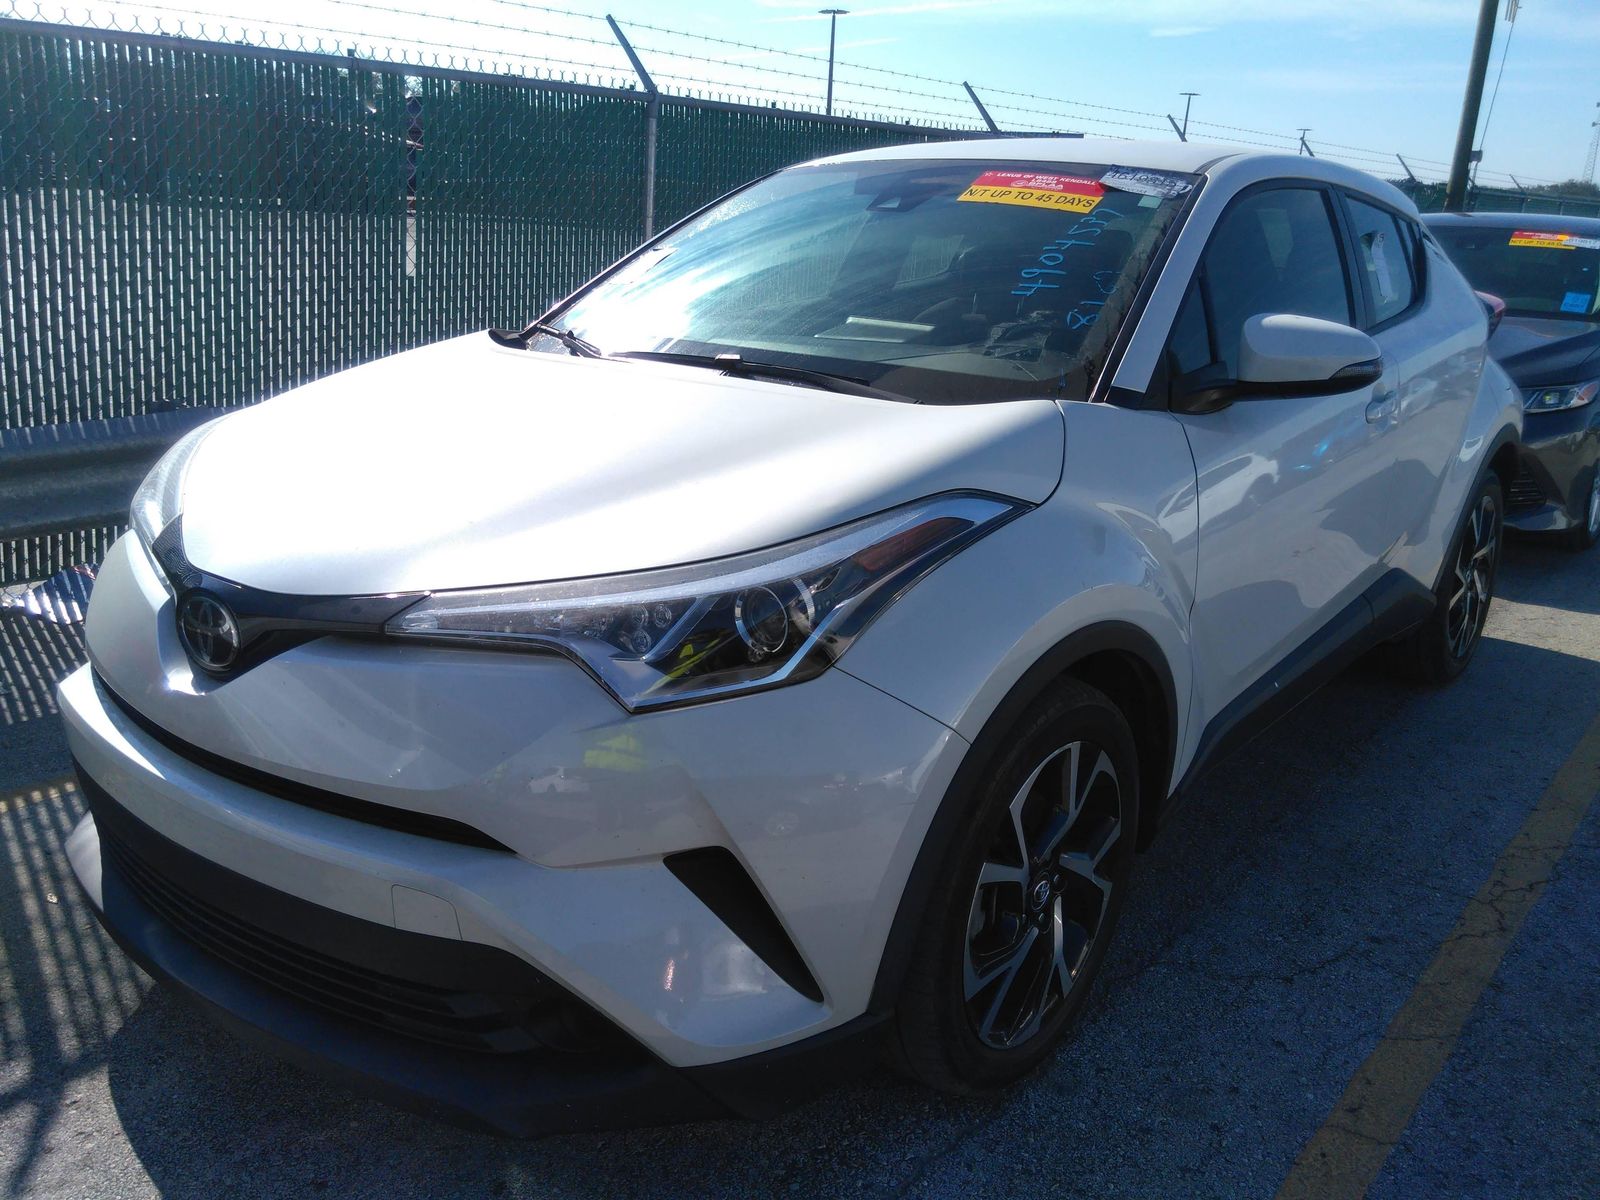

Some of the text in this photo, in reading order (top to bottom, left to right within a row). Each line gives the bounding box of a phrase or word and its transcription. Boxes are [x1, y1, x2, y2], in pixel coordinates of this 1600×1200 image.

[1060, 176, 1097, 185] KENDALL
[965, 188, 1095, 208] N/T UP TO 45 DAYS
